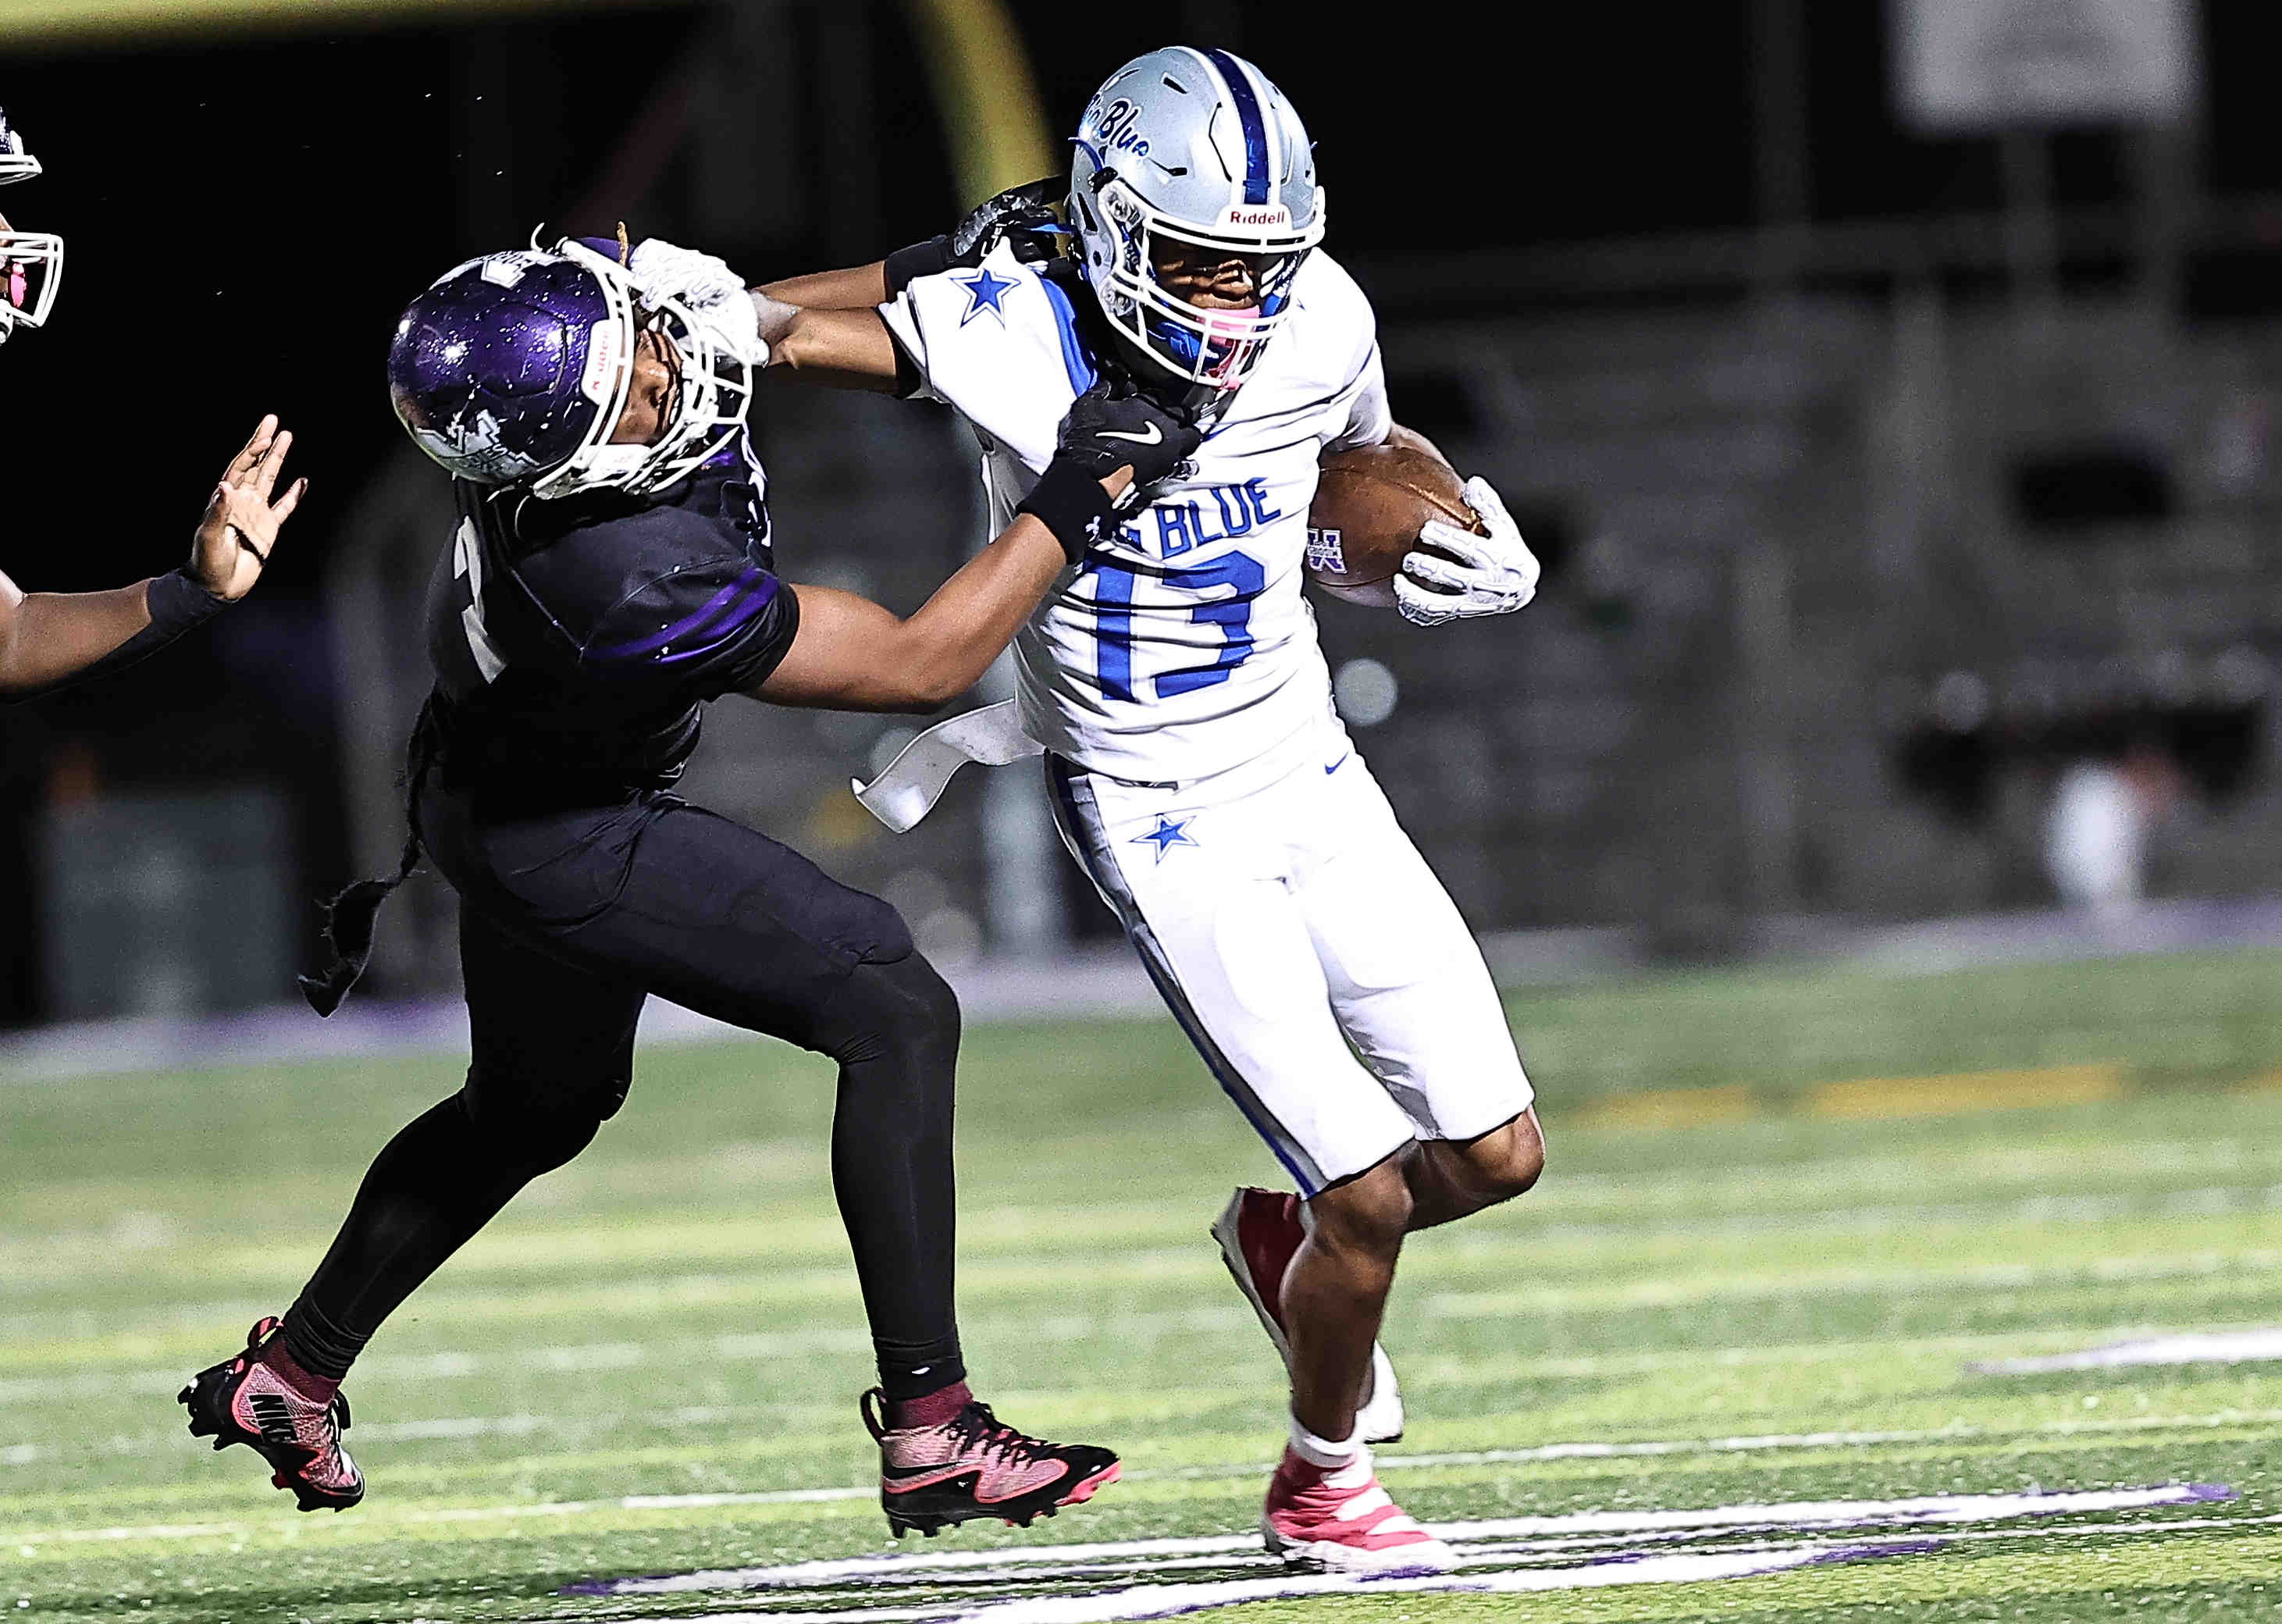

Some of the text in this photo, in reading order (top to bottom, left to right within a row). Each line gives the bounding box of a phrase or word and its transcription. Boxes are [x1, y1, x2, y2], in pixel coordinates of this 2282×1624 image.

[1230, 210, 1285, 225] Riddell
[1154, 477, 1281, 560] BLUE
[1084, 549, 1266, 701] 13
